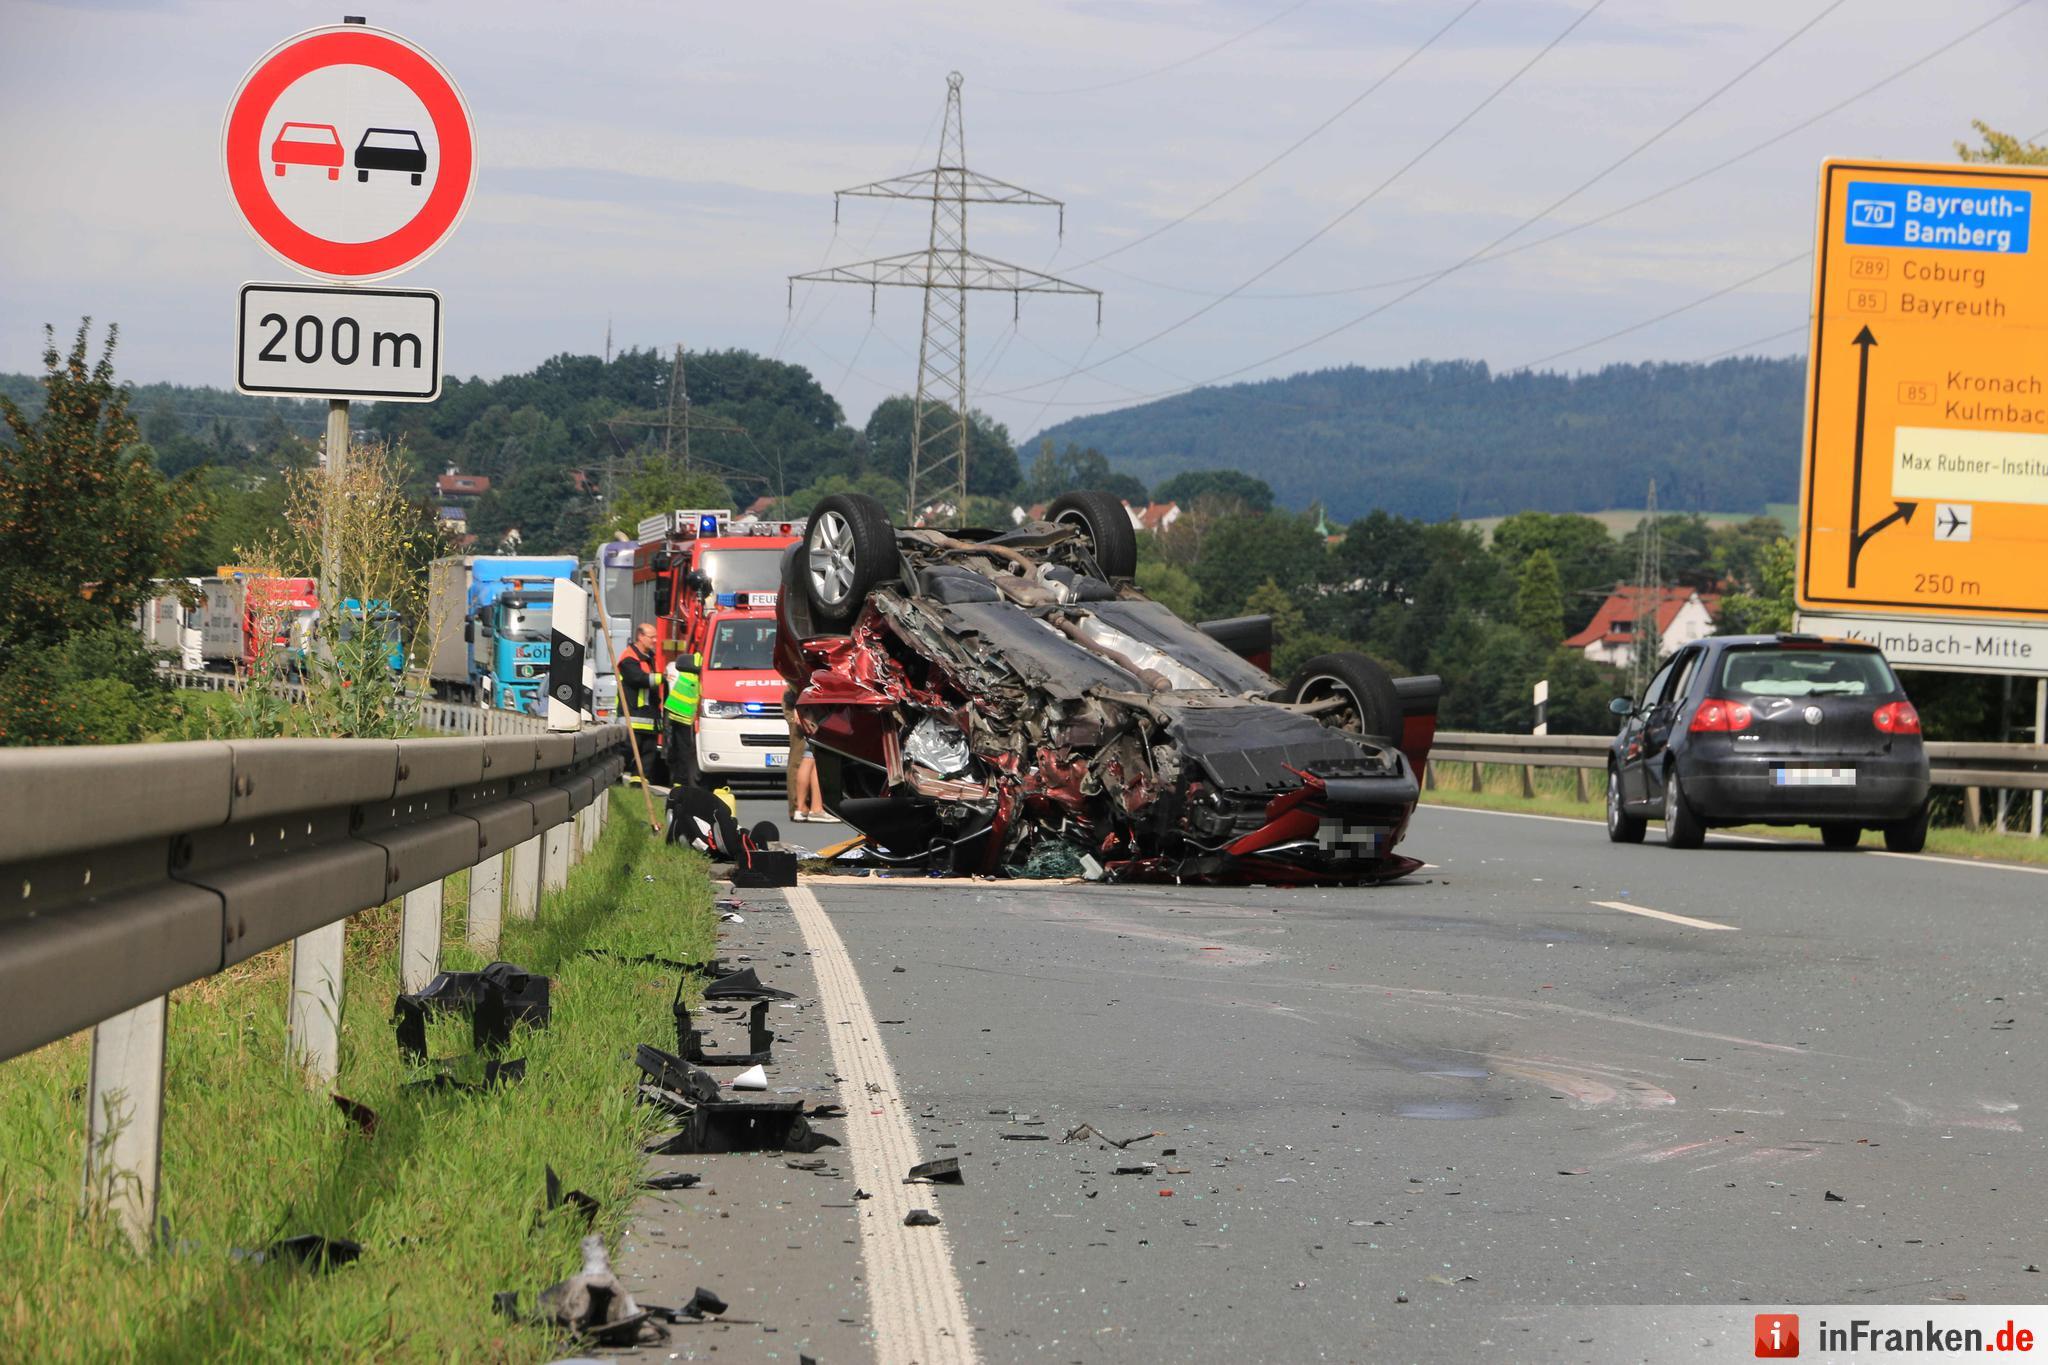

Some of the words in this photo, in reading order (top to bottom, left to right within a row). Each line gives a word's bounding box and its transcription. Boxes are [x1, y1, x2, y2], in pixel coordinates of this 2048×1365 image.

[1863, 205, 1884, 223] 70
[1906, 189, 2025, 219] Bayreuth-
[1904, 219, 2011, 252] Bamberg
[1855, 260, 1885, 276] 289
[1903, 260, 1986, 288] Coburg
[1857, 293, 1877, 309] 85
[1901, 292, 2006, 319] Bayreuth
[258, 313, 360, 366] 200
[372, 331, 422, 369] m
[1907, 386, 1927, 401] 85
[1947, 370, 2042, 395] Kronach
[1945, 399, 2048, 425] Kulmbac
[1901, 452, 1931, 471] Max
[1914, 573, 1954, 594] 250
[1960, 580, 1980, 596] m
